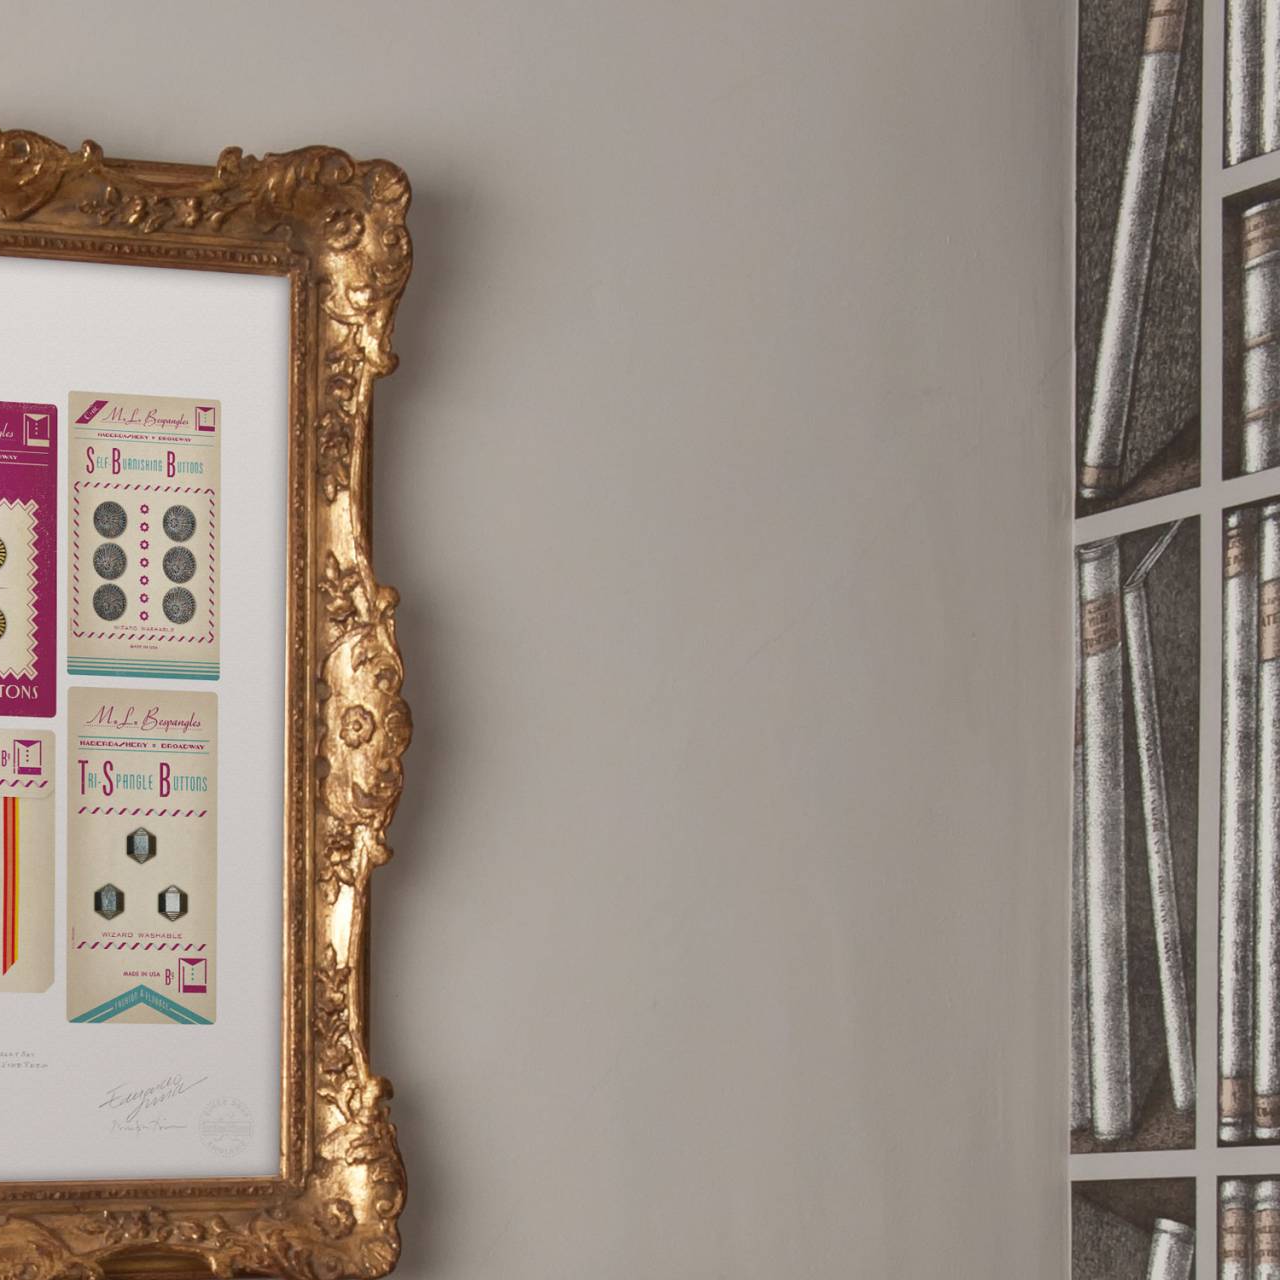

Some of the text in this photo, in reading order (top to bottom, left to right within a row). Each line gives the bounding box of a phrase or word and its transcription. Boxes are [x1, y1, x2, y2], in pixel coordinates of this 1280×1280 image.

[167, 450, 204, 477] BUTTONS
[141, 706, 201, 733] Bespangles
[78, 760, 208, 798] TRI-SPANGLE BUTTONS
[138, 932, 183, 940] WASHABLE
